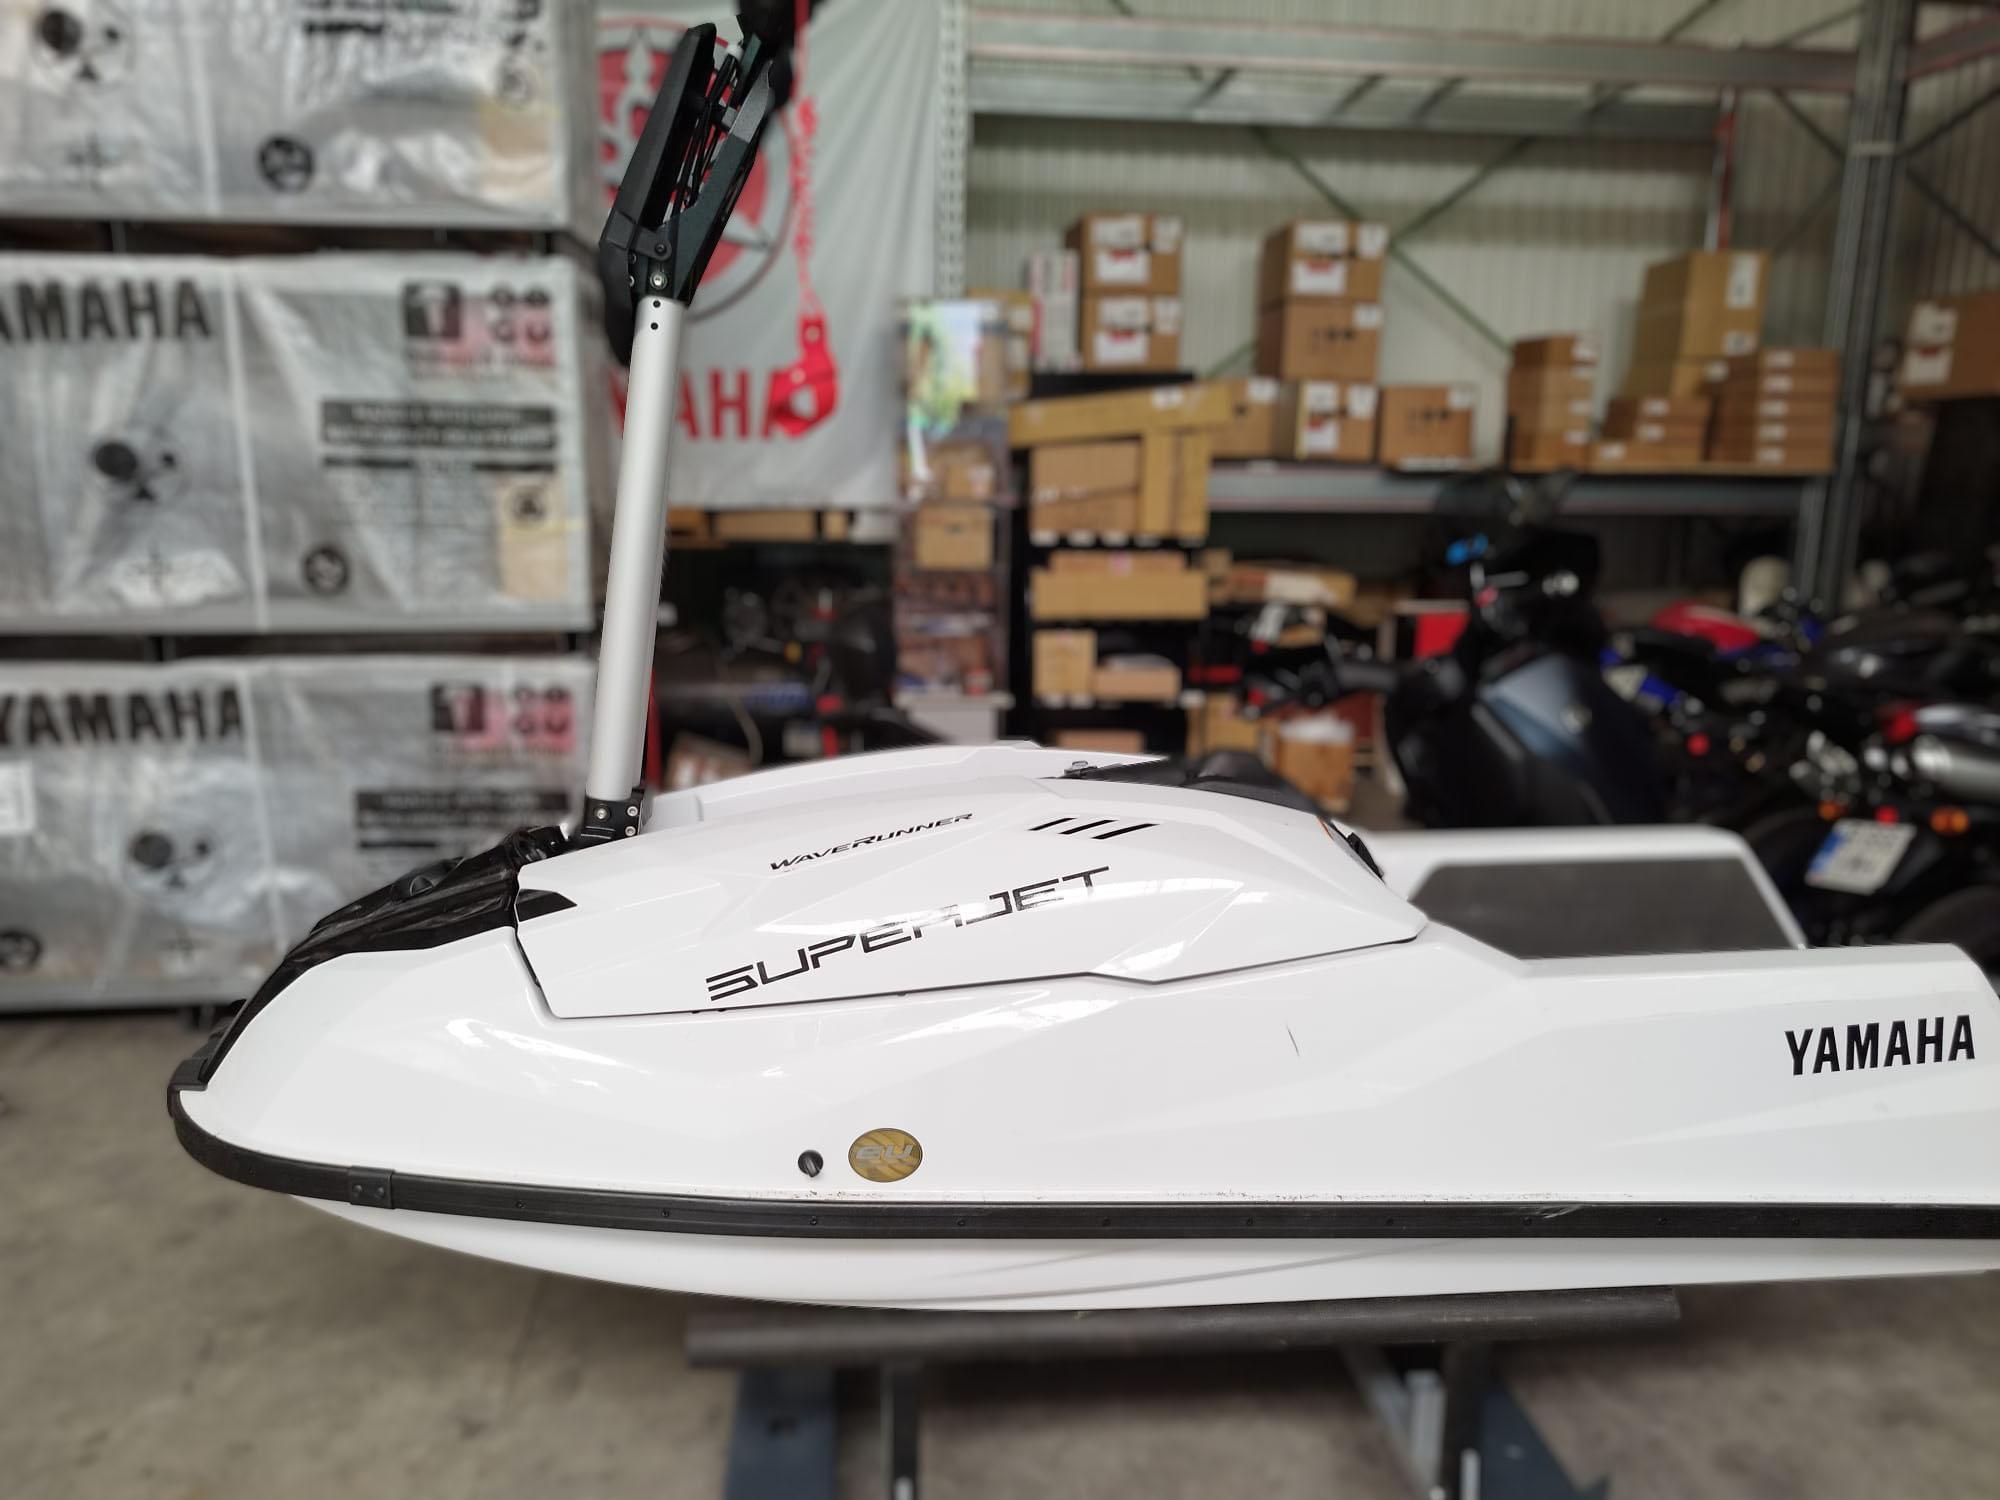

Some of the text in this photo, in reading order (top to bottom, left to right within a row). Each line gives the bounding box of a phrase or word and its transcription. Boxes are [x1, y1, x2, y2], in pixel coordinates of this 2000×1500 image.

[771, 813, 972, 871] WAVERUNNER
[705, 865, 1110, 1002] SUPERJET
[1785, 1014, 1976, 1076] YAMAHA
